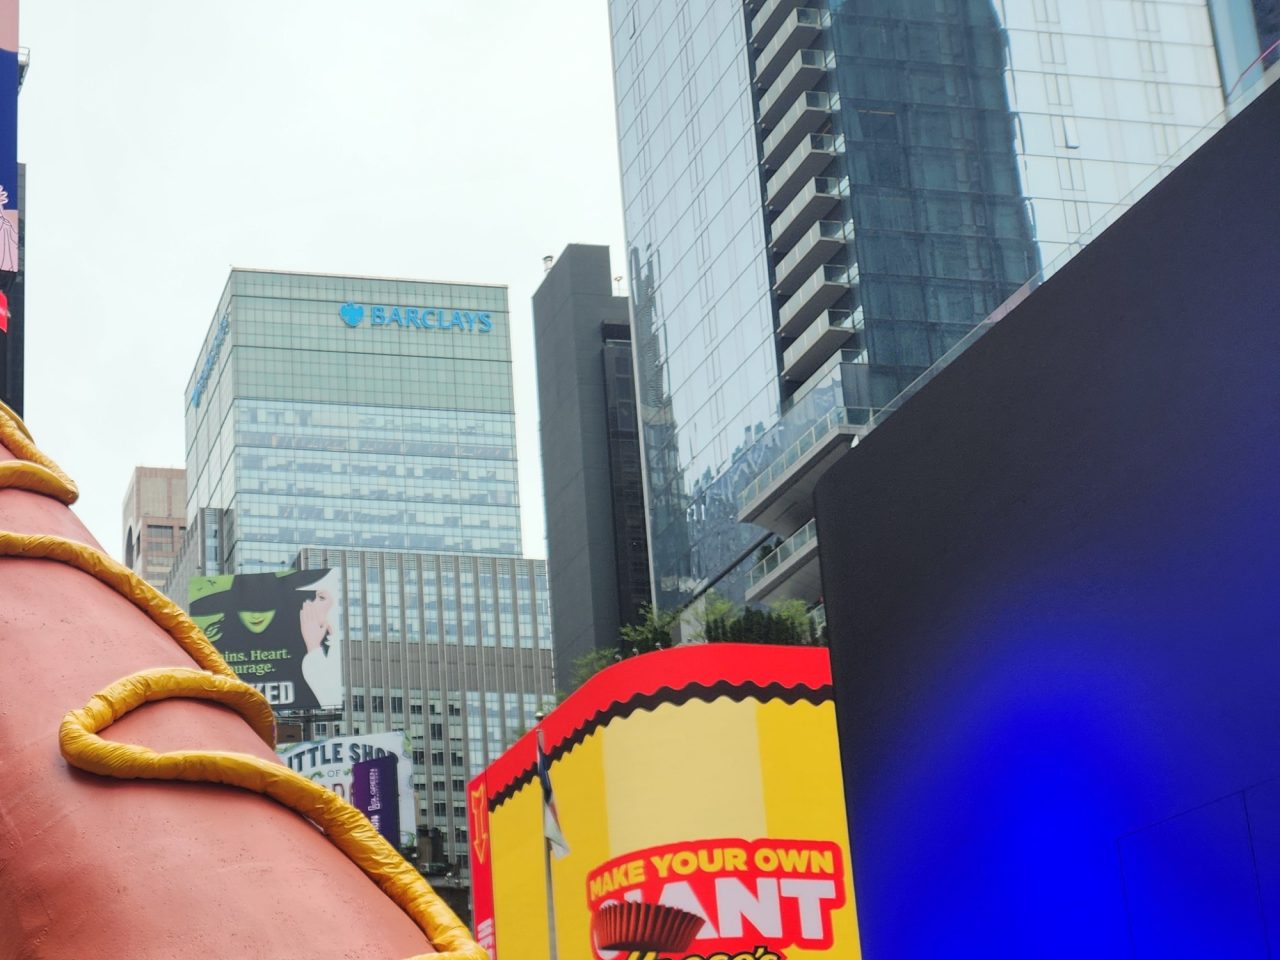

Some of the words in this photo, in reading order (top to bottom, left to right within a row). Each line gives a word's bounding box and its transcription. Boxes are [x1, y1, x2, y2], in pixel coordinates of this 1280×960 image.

[371, 305, 494, 333] BARCLAYS
[225, 651, 248, 662] ins.
[250, 648, 291, 661] Heart.
[231, 663, 276, 676] urage.
[287, 742, 343, 772] ITTLE
[327, 769, 340, 778] OF
[589, 859, 645, 900] MAKE
[651, 847, 748, 878] YOUR
[754, 848, 834, 874] OWN
